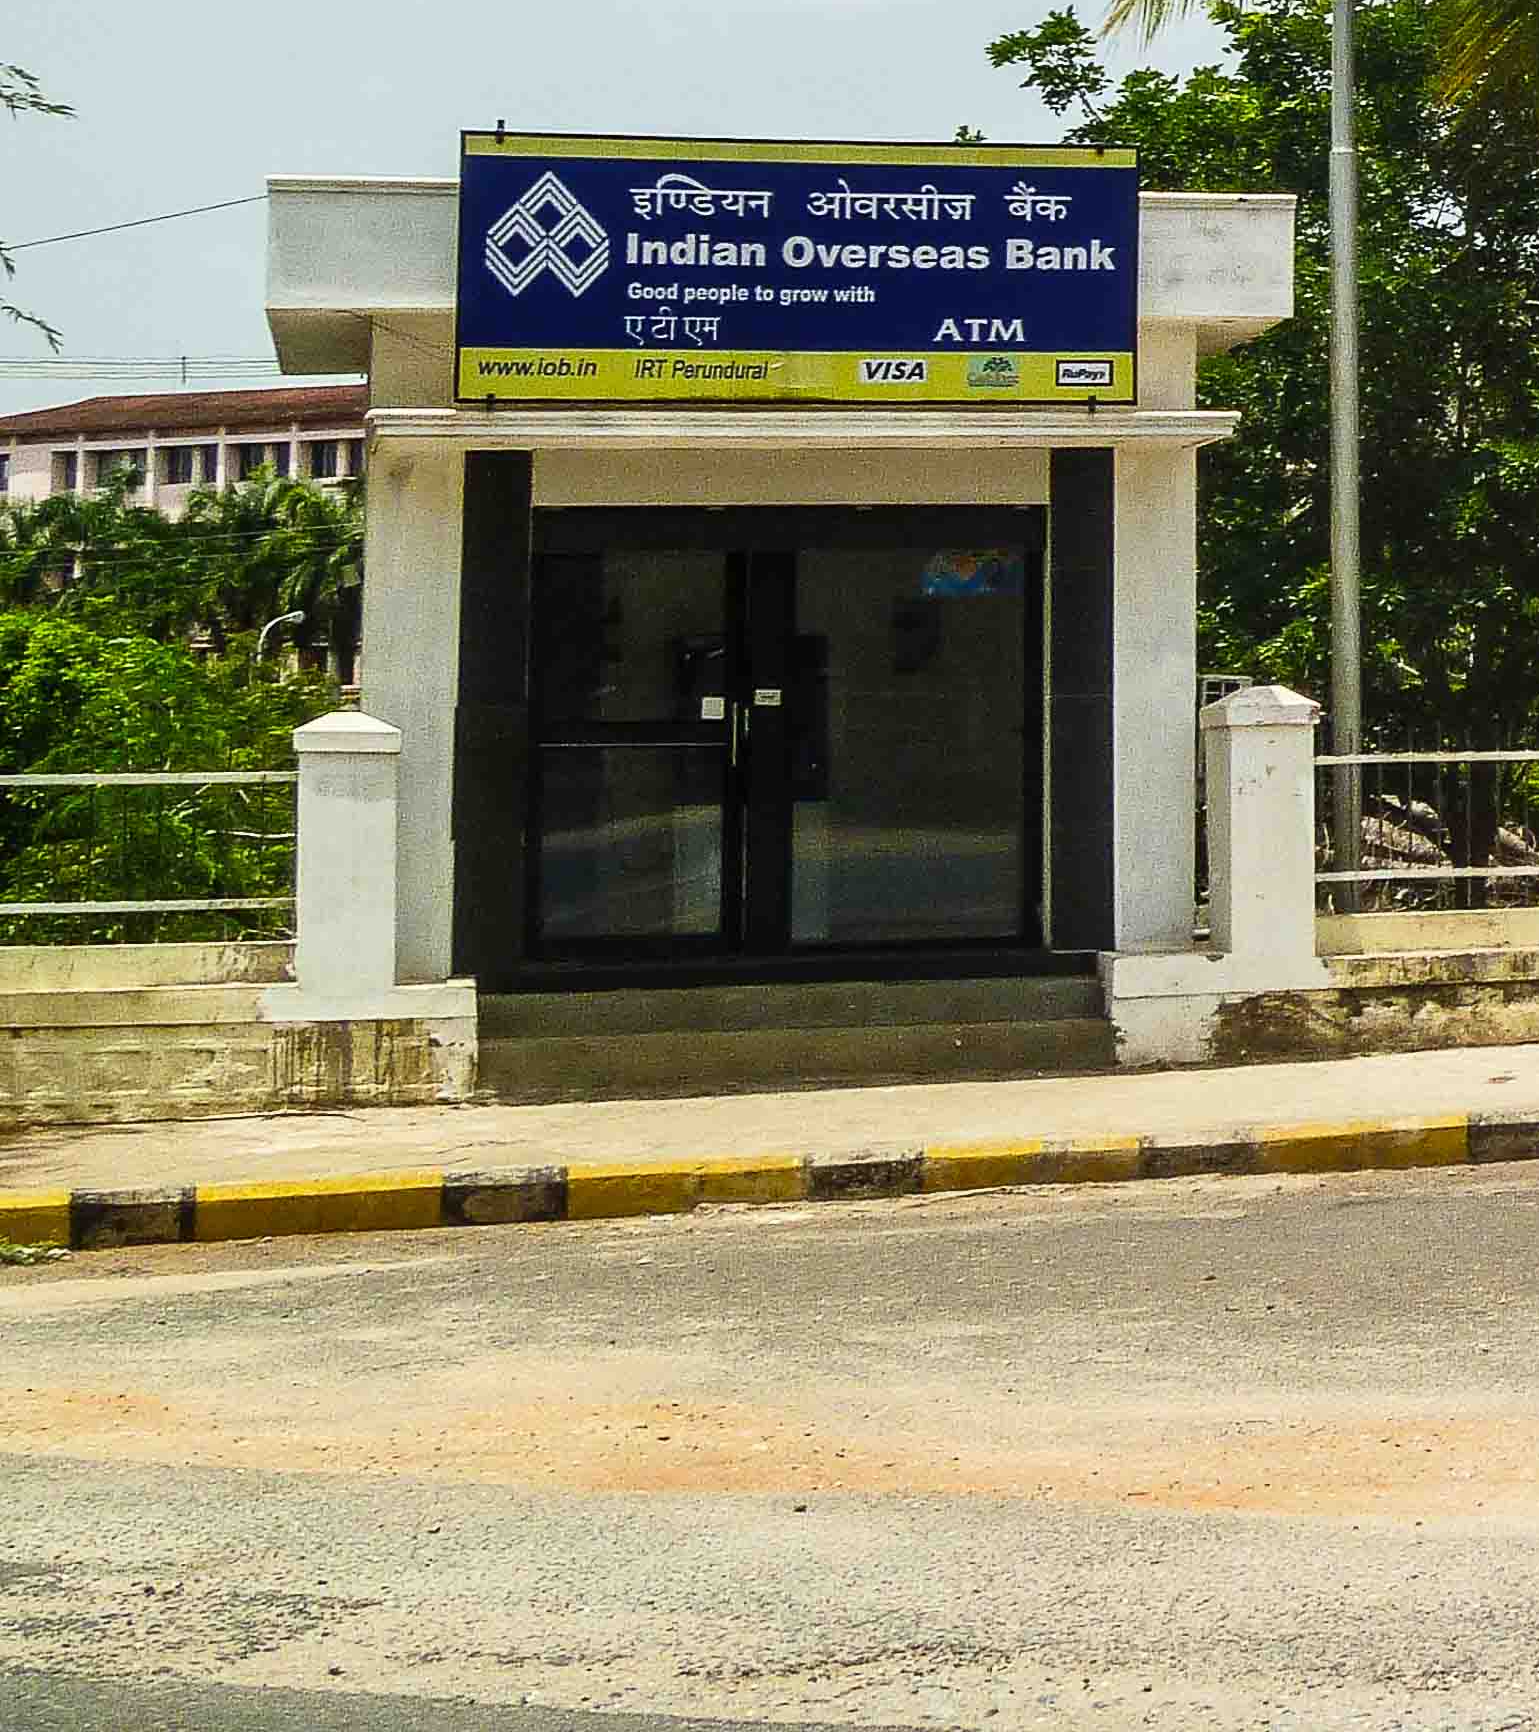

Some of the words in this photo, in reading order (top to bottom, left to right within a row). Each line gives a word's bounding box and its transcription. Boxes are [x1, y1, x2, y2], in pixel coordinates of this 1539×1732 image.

[629, 173, 773, 220] इण्डियन
[1003, 181, 1073, 222] बैंक
[626, 232, 767, 267] Indian
[782, 235, 990, 269] Overseas
[1006, 238, 1116, 271] Bank
[627, 282, 679, 300] Good
[683, 283, 749, 305] people
[754, 285, 774, 301] to
[779, 288, 828, 306] grow
[833, 286, 876, 303] with
[624, 315, 646, 346] ए
[649, 306, 678, 341] टी
[933, 318, 1025, 342] ATM
[478, 357, 598, 378] www.iob.in
[634, 359, 667, 377] IRT
[670, 359, 768, 381] Perundurai
[863, 361, 926, 381] VISA
